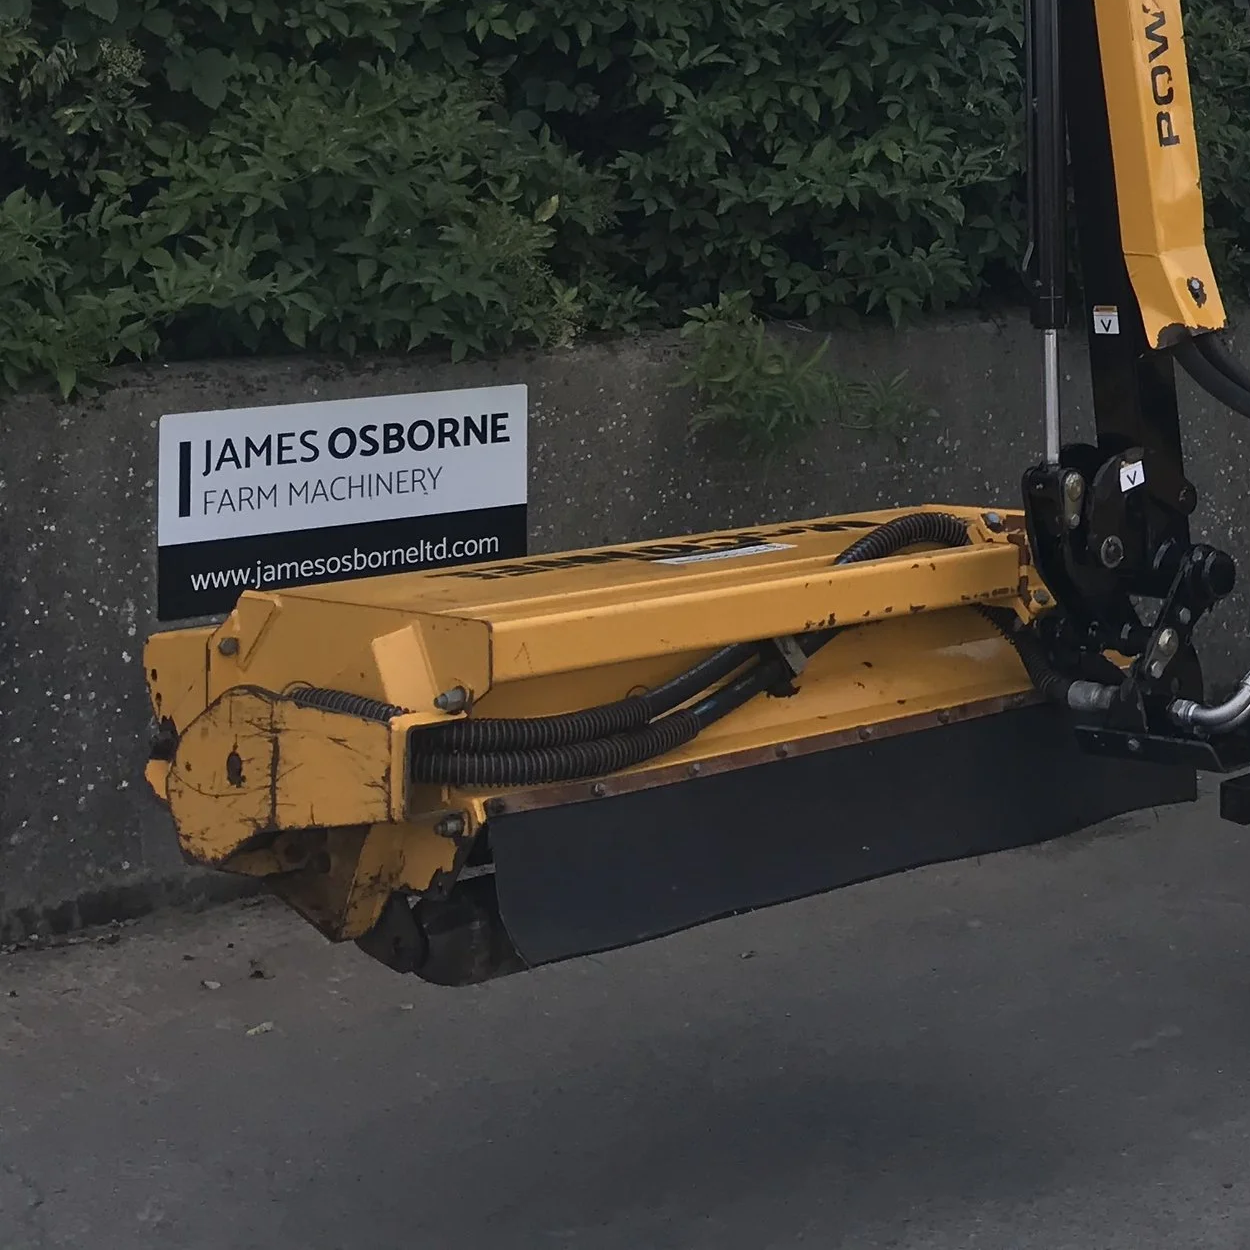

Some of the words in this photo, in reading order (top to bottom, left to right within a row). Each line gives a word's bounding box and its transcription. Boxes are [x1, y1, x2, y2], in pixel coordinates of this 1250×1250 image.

[1100, 319, 1112, 333] V
[202, 429, 320, 477] JAMES
[327, 412, 511, 460] OSBORNE
[203, 484, 278, 515] FARM
[288, 466, 443, 507] MACHINERY
[1126, 470, 1137, 485] V
[190, 535, 499, 591] www.jamesosborneltd.com
